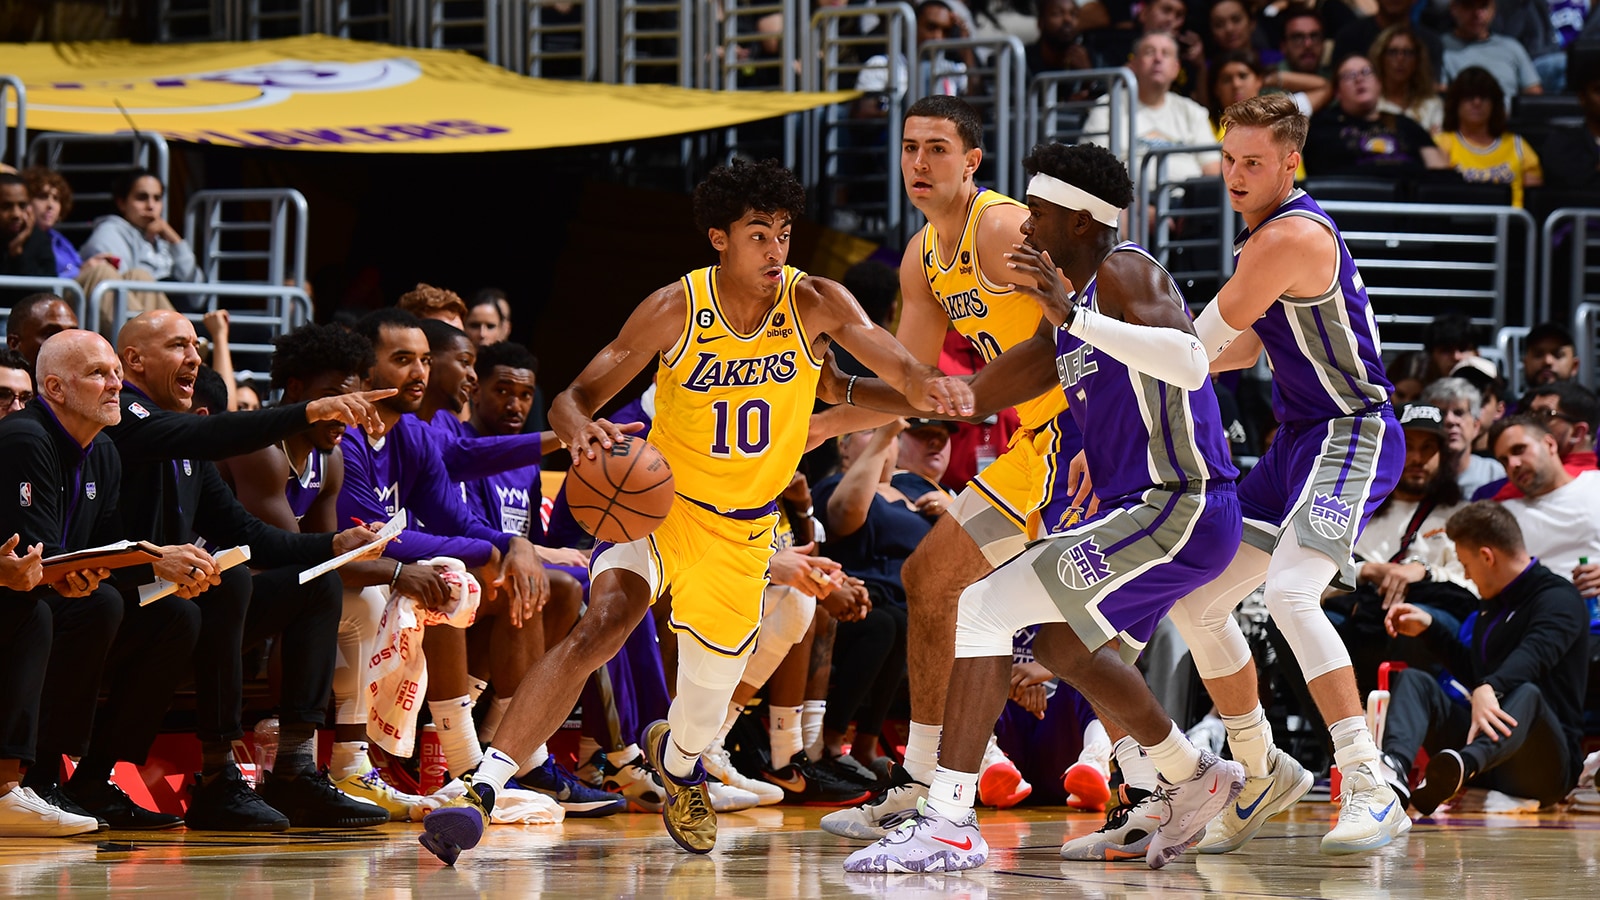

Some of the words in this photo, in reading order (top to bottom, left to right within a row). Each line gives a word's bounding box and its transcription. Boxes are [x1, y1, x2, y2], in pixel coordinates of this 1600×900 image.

[700, 311, 711, 327] 6
[766, 327, 793, 339] bibigo
[681, 350, 798, 393] LAKERS
[710, 398, 771, 458] 10
[1311, 506, 1349, 529] SAC
[1068, 545, 1099, 586] SAC
[402, 681, 419, 711] BIO
